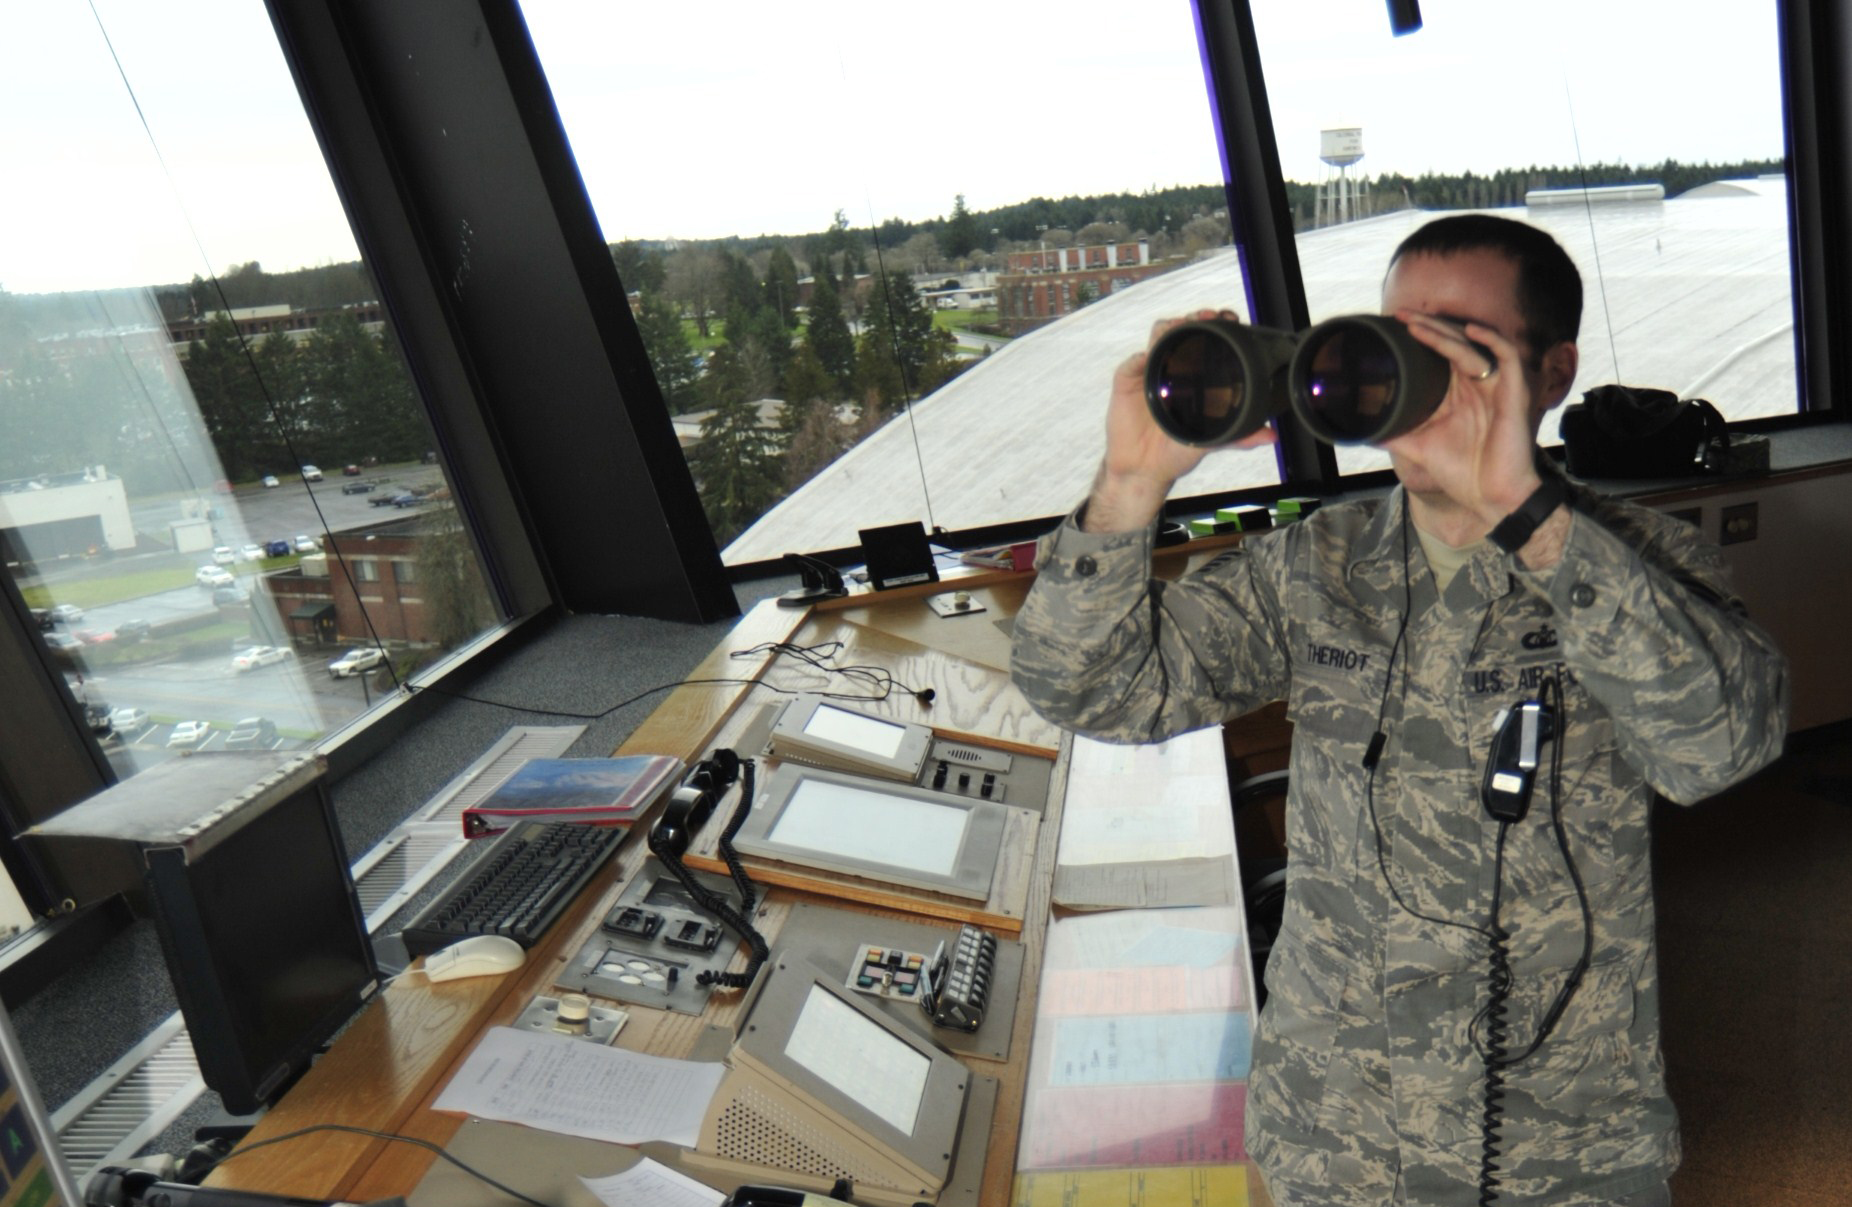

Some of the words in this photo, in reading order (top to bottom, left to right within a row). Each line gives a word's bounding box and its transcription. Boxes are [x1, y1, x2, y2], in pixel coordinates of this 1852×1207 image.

[1307, 642, 1370, 672] THERIOT
[1474, 669, 1504, 694] U.S.
[1518, 665, 1546, 691] AIR
